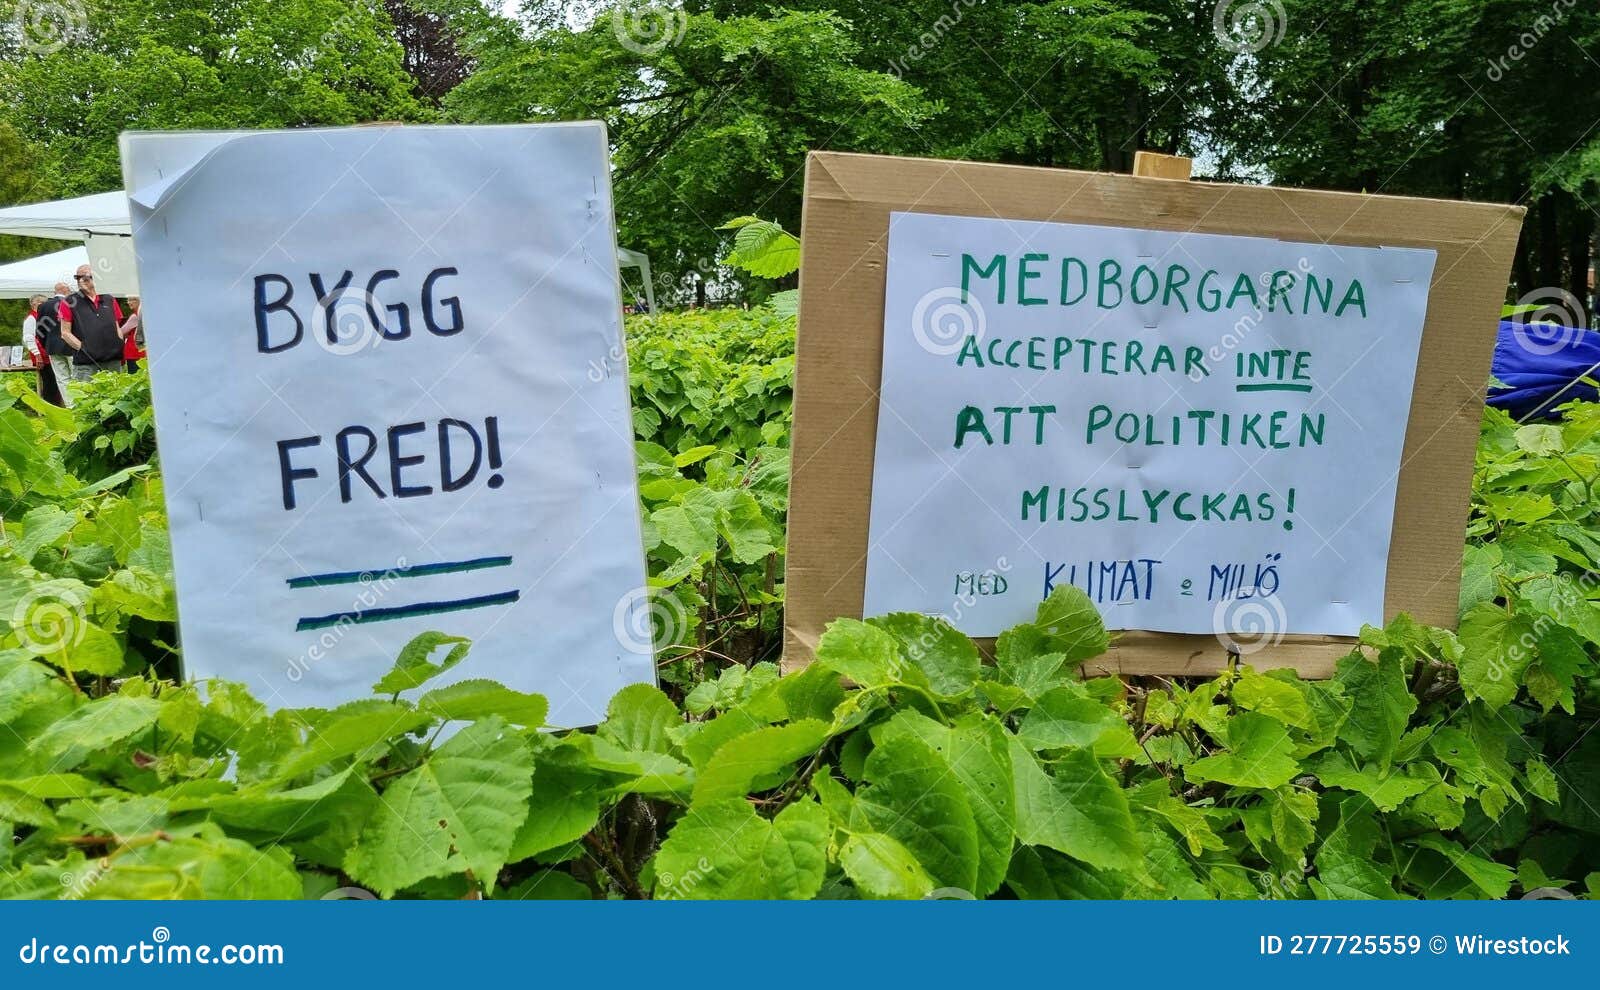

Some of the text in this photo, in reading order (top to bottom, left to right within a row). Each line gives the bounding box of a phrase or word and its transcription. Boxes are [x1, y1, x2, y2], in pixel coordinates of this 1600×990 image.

[253, 266, 466, 355] BYGG
[961, 252, 1367, 319] MEDBORGARNA
[957, 334, 1313, 393] ACCEPTERAR INTE
[954, 404, 1326, 450] ATT POLITIKEN
[276, 416, 505, 511] FRED!
[1022, 485, 1296, 532] MISSLYCKAS!
[954, 573, 1008, 596] MED
